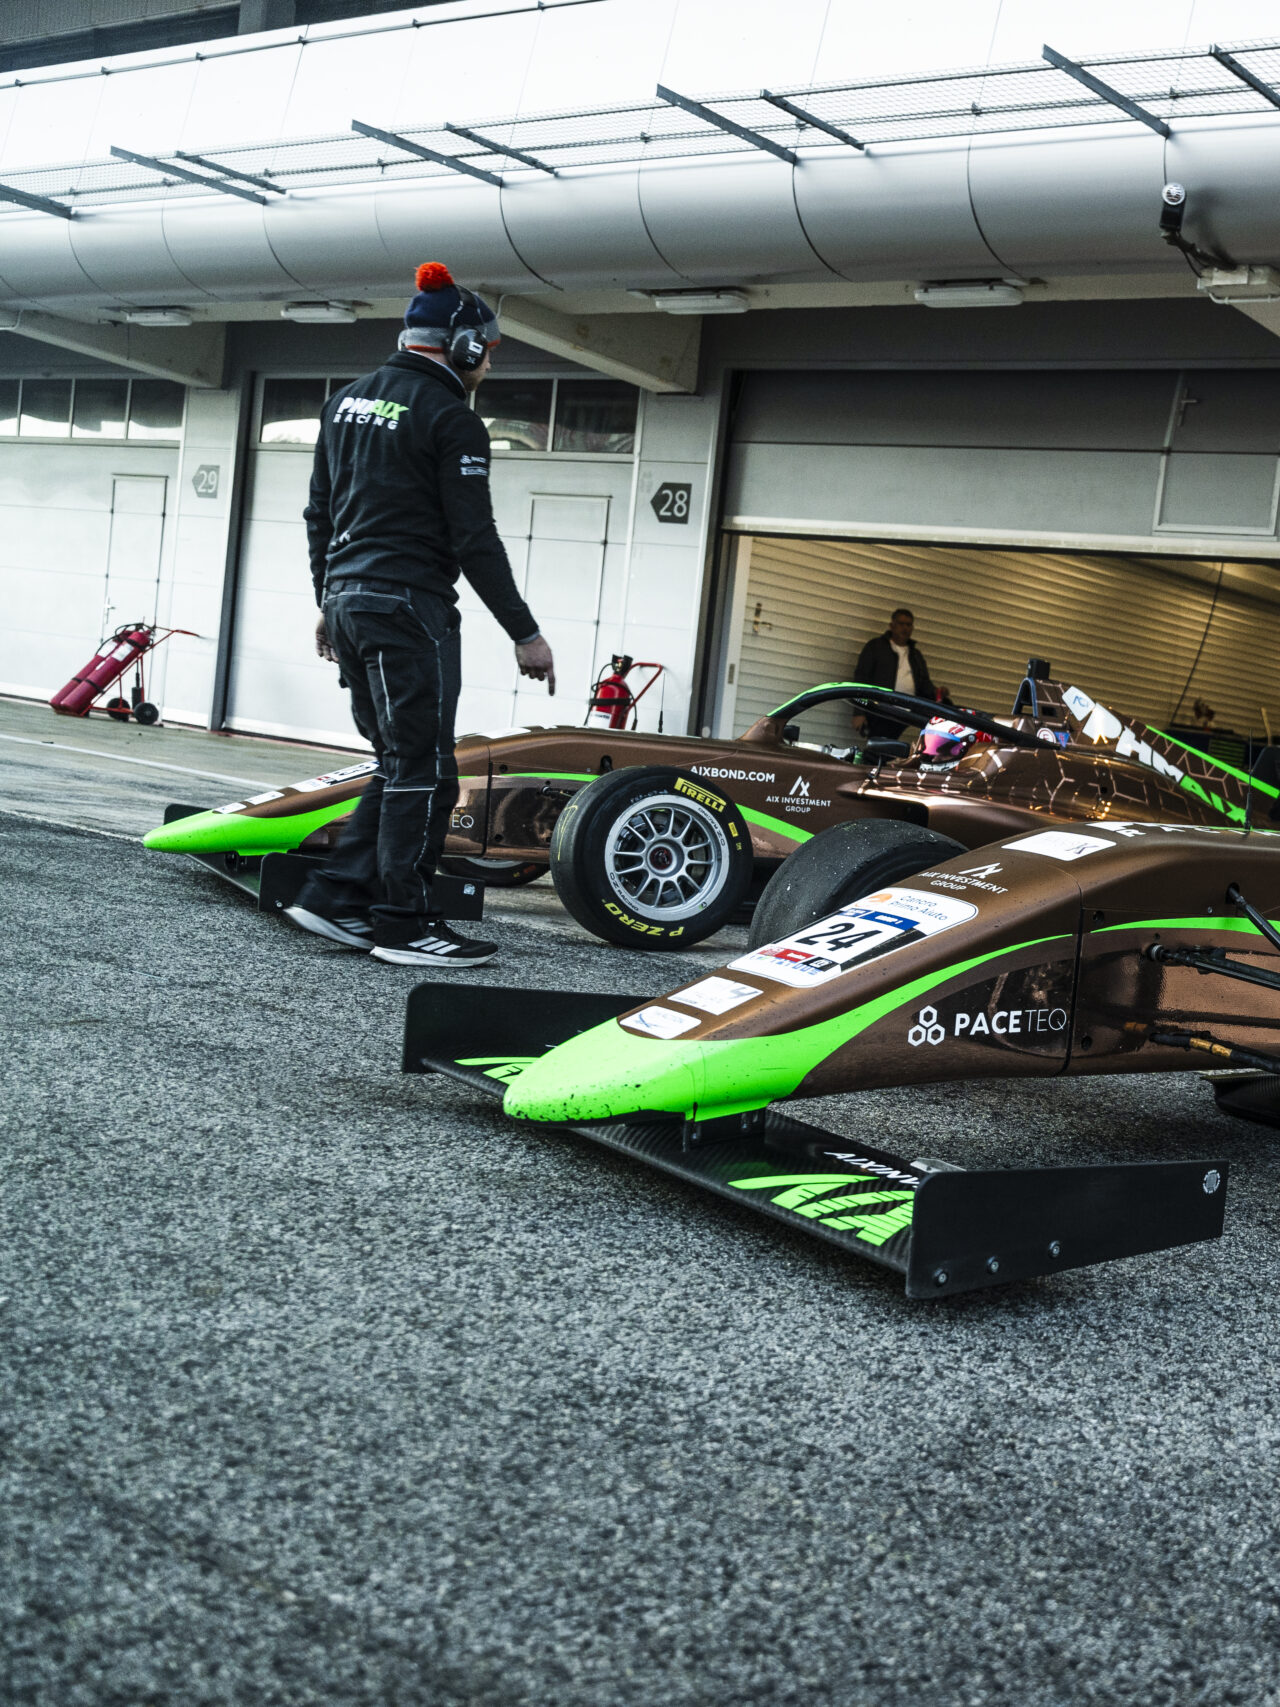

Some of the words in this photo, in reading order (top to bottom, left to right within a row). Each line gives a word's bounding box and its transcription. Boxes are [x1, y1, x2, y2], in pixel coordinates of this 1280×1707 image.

[333, 413, 399, 430] RACING
[198, 471, 217, 493] 29
[660, 489, 688, 517] 28
[690, 765, 776, 783] AIXBOND.COM
[674, 777, 727, 813] PIRELLI
[765, 795, 780, 803] AIX
[781, 796, 832, 807] INVESTMENT
[917, 871, 938, 879] AIX
[939, 873, 1008, 894] INVESTMENT
[930, 880, 967, 891] GROUP
[604, 902, 664, 936] ZERO
[919, 905, 948, 921] Aiuto
[669, 926, 684, 936] P
[795, 922, 883, 951] 24
[954, 1008, 1067, 1036] PACETEQ
[824, 1151, 920, 1188] AIXINV
